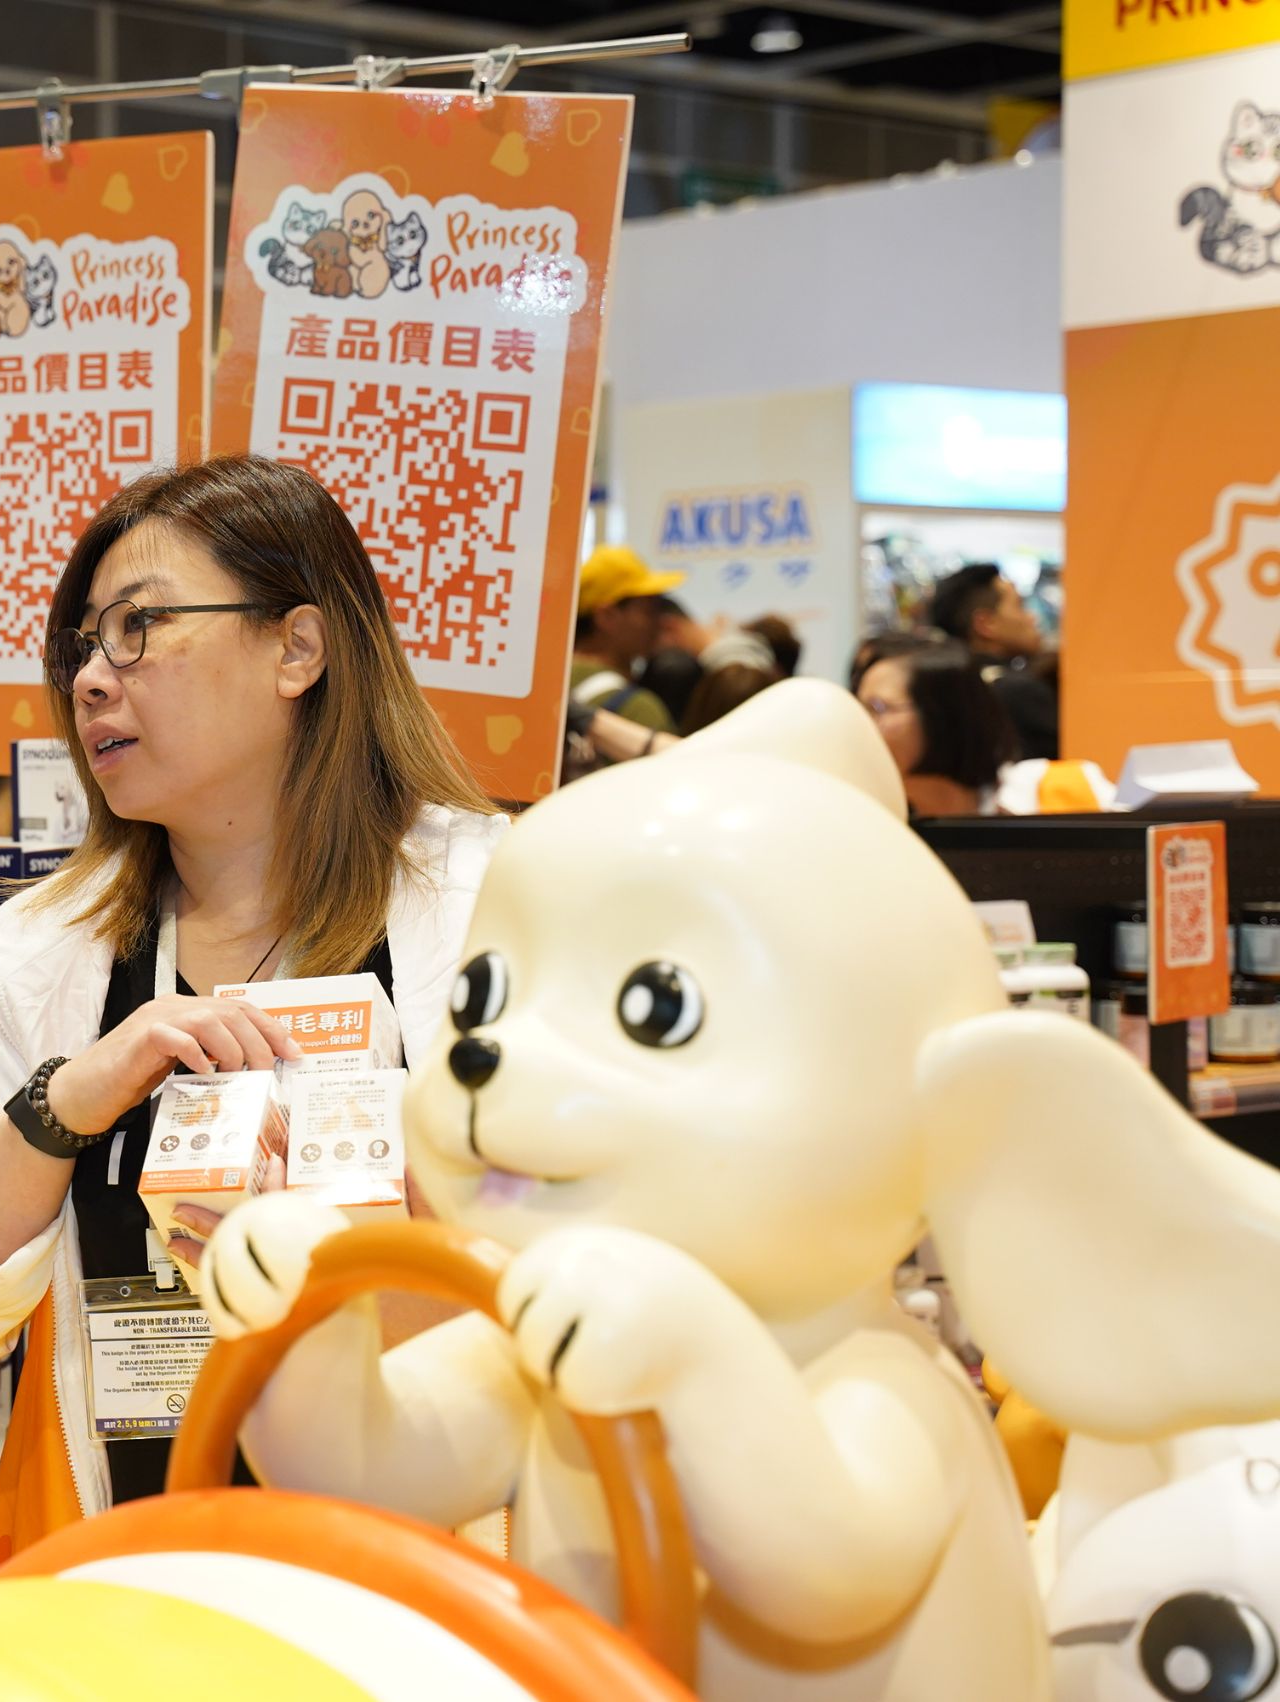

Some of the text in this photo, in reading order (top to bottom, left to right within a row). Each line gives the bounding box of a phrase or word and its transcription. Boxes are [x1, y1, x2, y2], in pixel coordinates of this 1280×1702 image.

[446, 211, 564, 255] Princess
[71, 249, 166, 289] Princess
[429, 252, 574, 300] Parad
[61, 282, 179, 331] Paradise
[285, 313, 535, 374] 產品價目表
[660, 491, 811, 551] AKUSA
